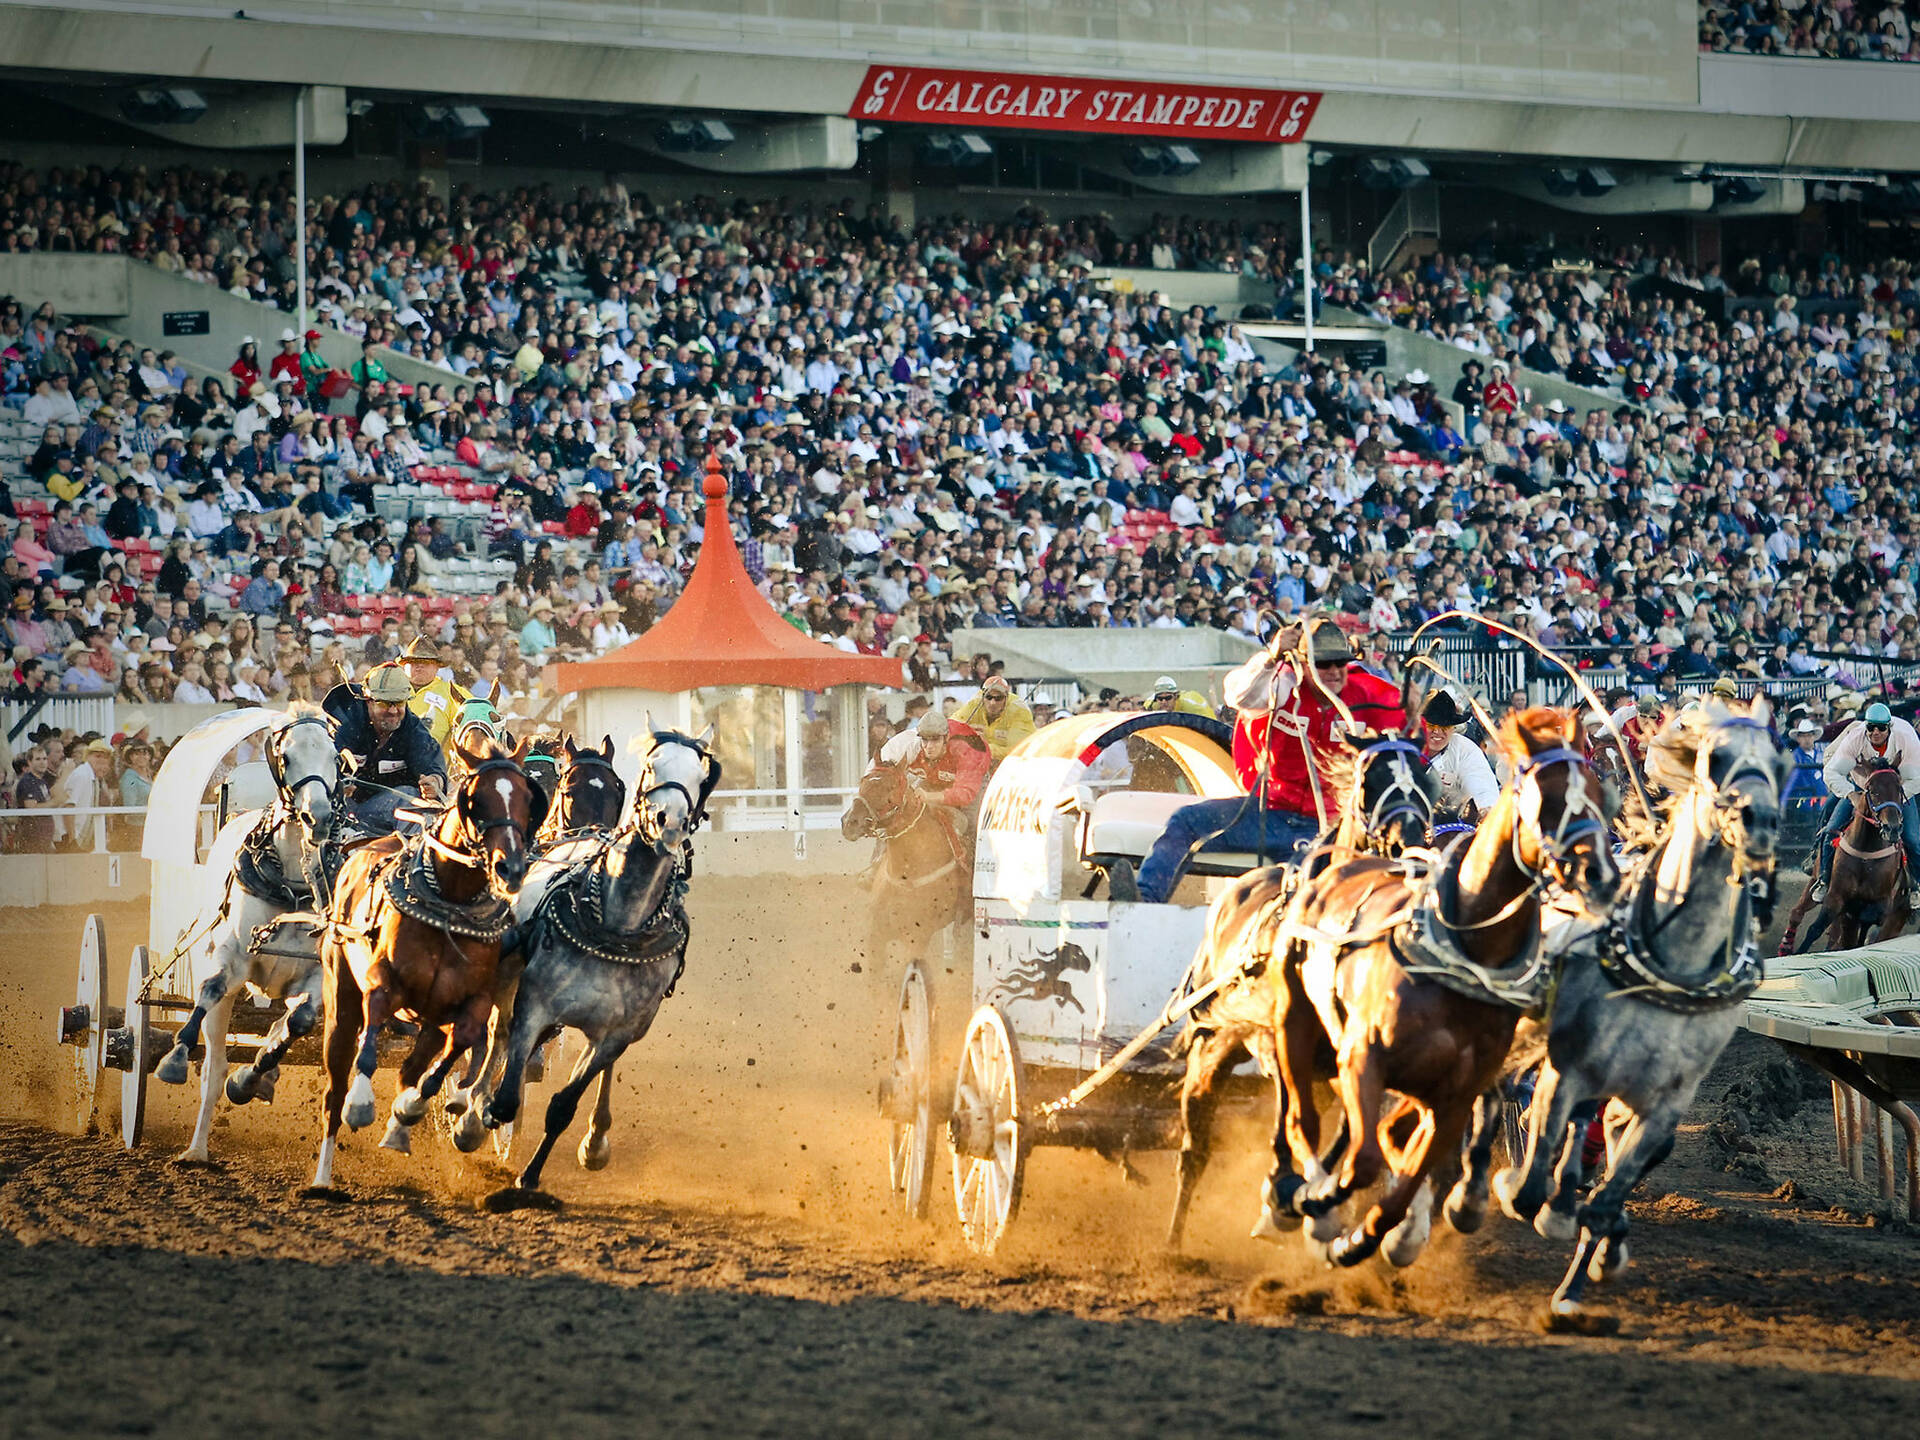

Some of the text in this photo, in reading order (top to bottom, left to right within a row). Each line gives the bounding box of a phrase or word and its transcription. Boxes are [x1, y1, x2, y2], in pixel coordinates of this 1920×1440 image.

[916, 79, 1264, 129] CALGARY STAMPEDE
[796, 834, 805, 856] 4
[111, 858, 118, 883] 1
